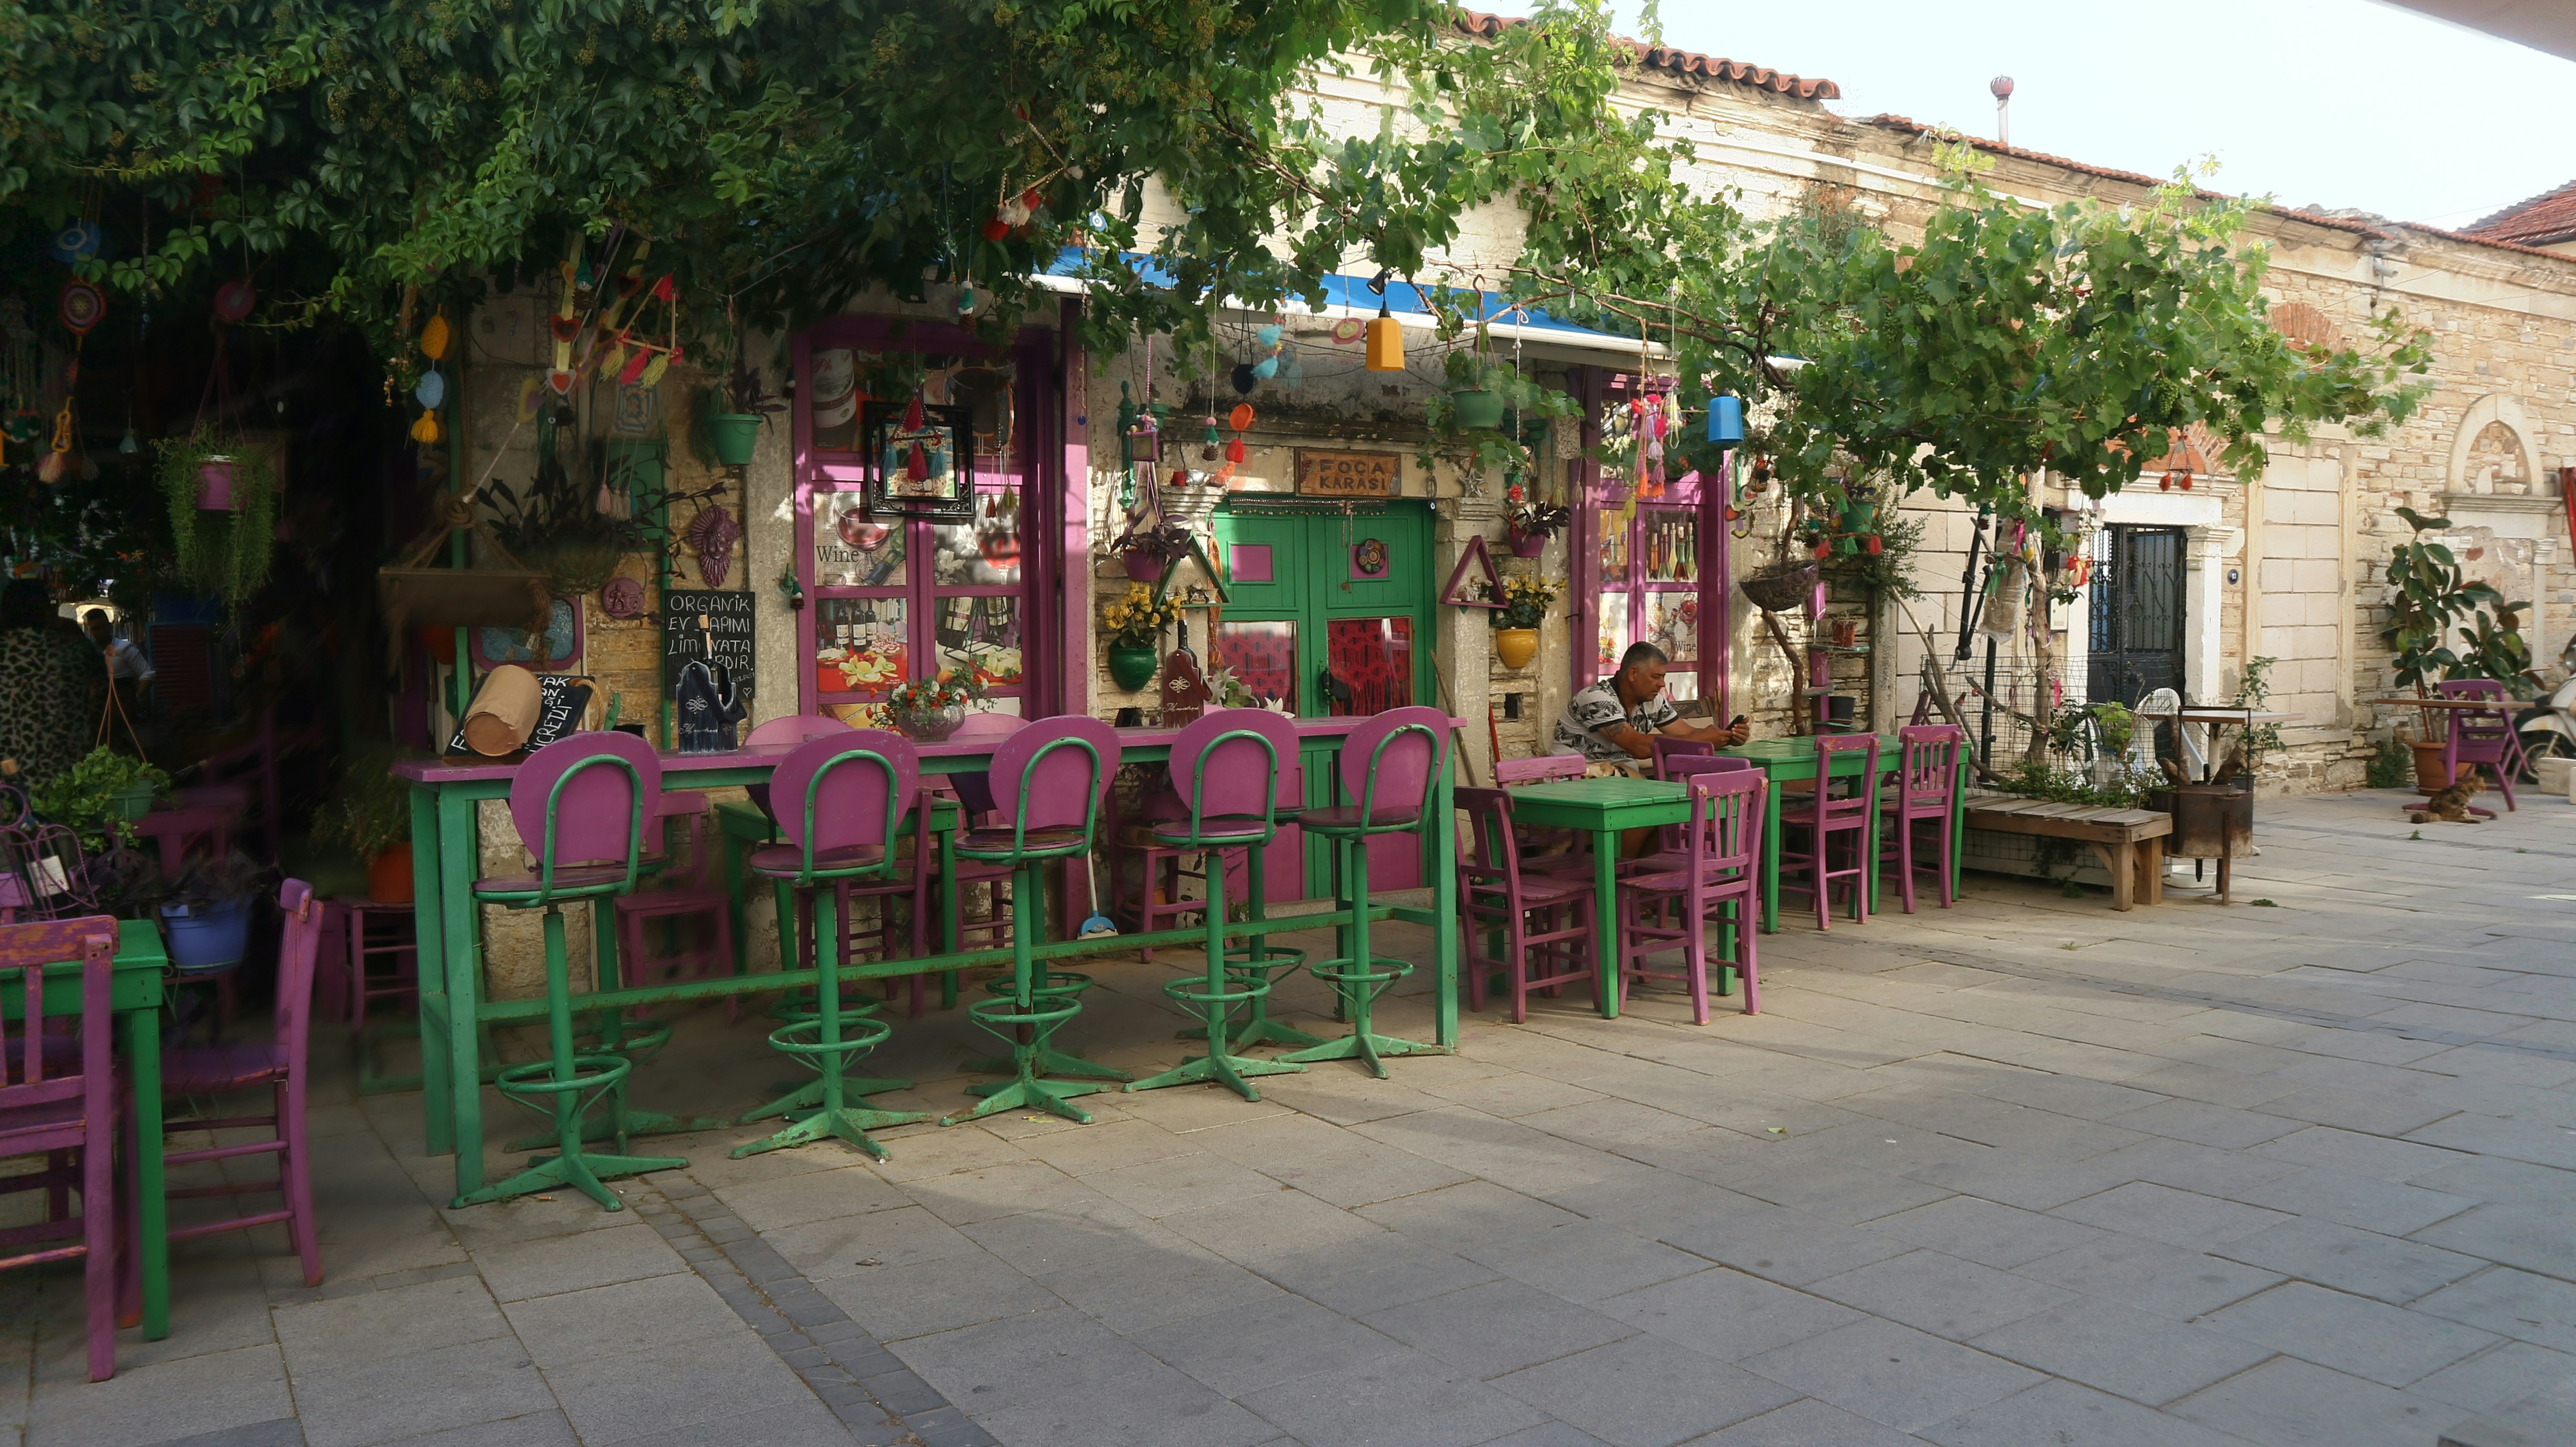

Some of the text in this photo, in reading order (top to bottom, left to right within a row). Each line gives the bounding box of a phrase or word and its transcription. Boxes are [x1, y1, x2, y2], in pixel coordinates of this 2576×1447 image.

[1320, 476, 1386, 490] KARASI
[816, 546, 859, 563] Wine
[668, 617, 691, 630] EV
[668, 634, 750, 655] LİMNATA
[1675, 641, 1696, 651] Wine
